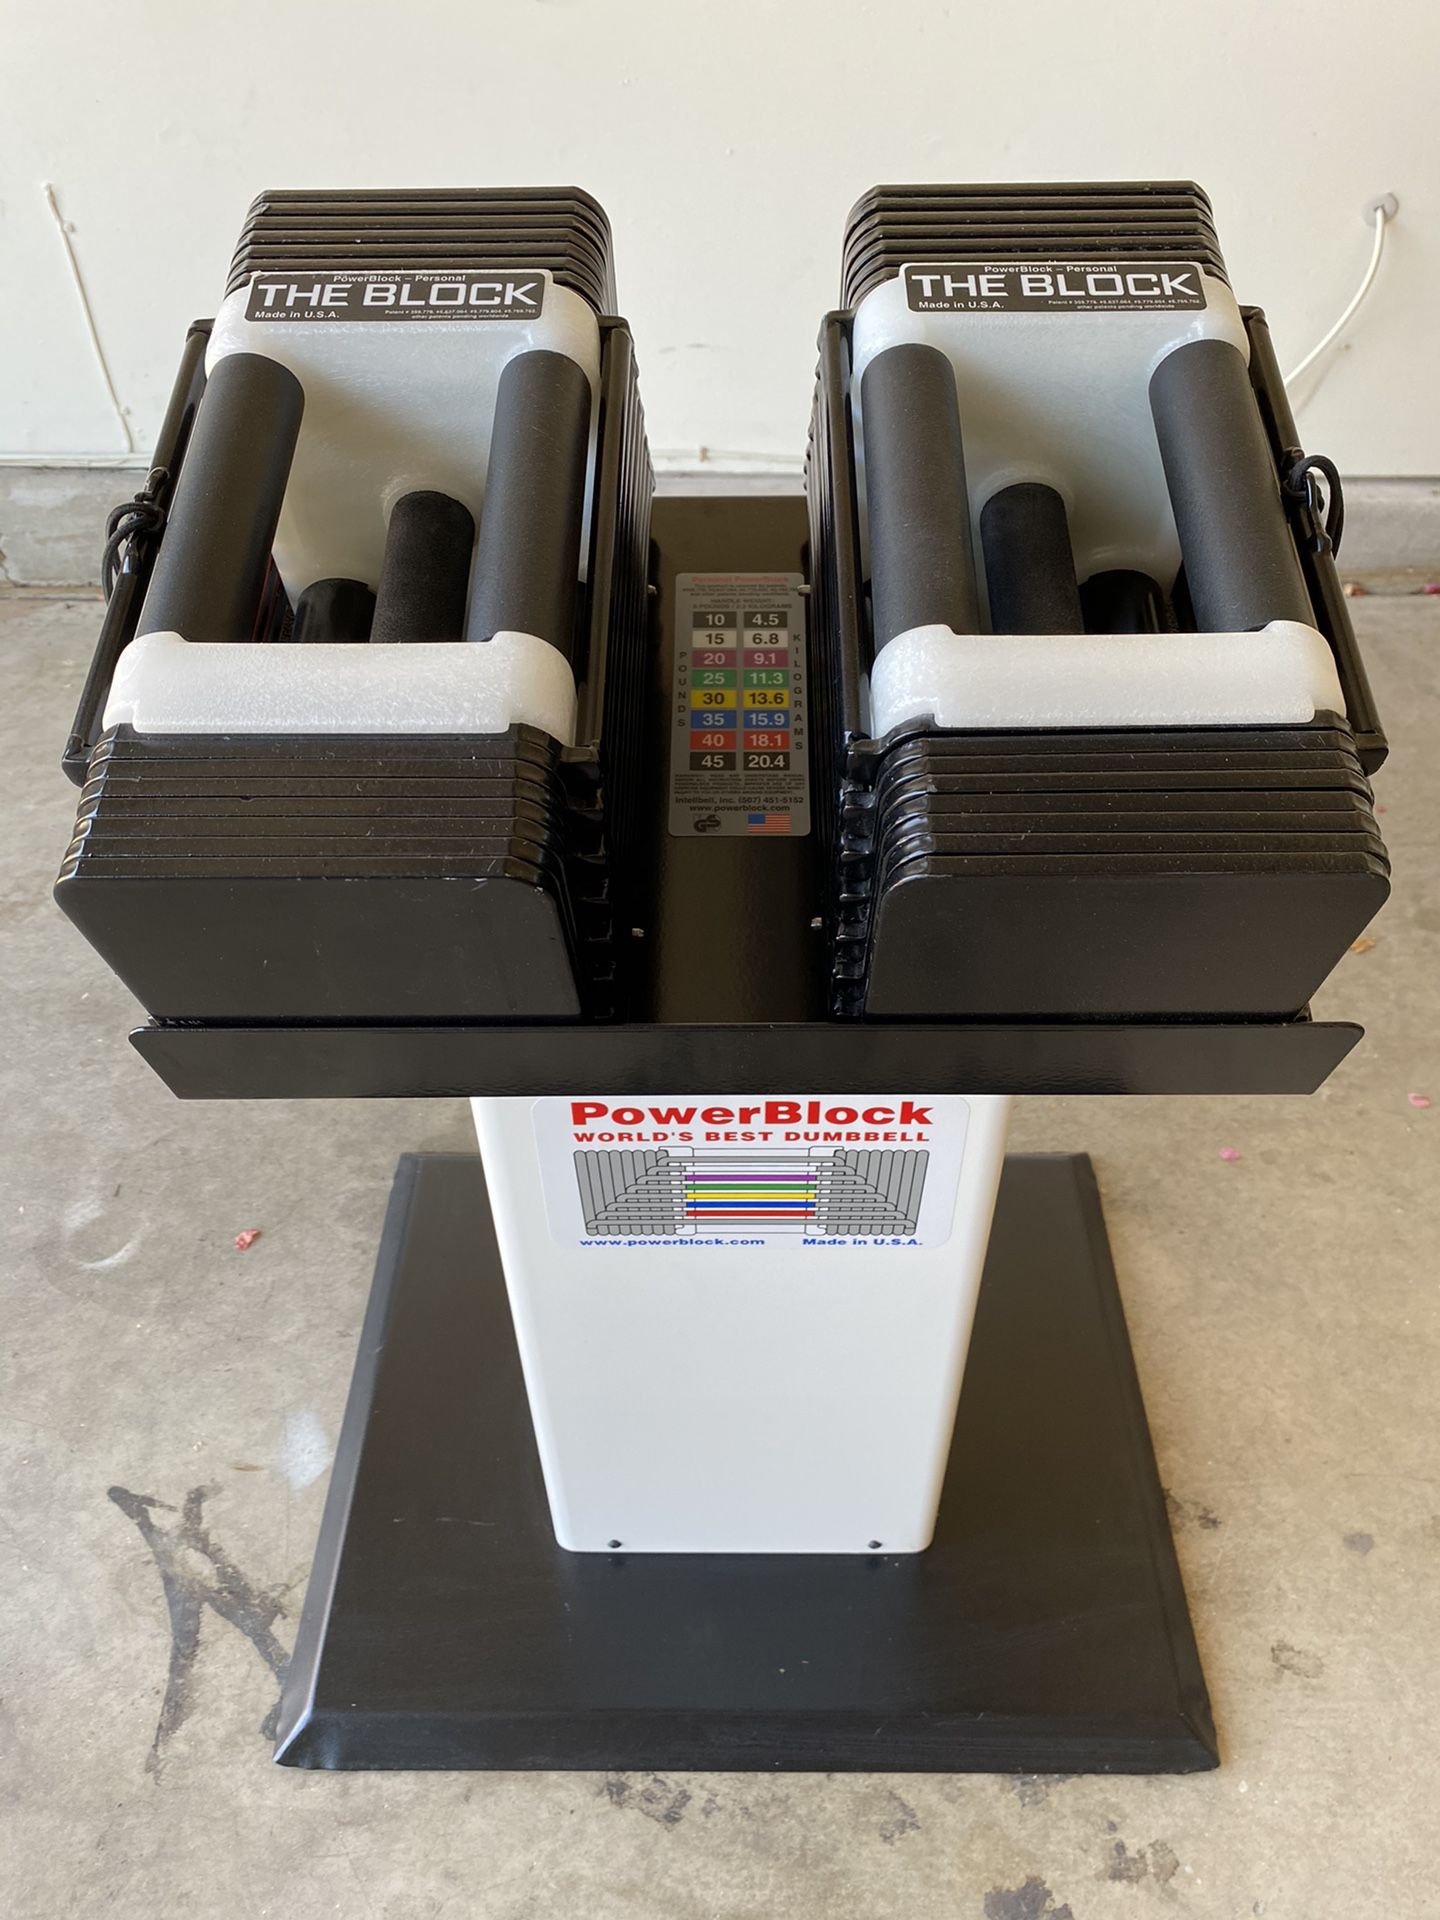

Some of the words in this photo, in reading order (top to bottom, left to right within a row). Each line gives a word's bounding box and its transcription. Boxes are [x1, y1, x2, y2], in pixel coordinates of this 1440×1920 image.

[984, 265, 1053, 273] PowerBlock
[1066, 265, 1117, 273] Personal
[911, 274, 1009, 297] THE
[1020, 273, 1199, 296] BLOCK
[257, 283, 353, 307] THE
[362, 282, 538, 306] BLOCK
[705, 614, 725, 625] 10
[752, 614, 779, 625] 4.5
[705, 633, 724, 644] 15
[752, 633, 779, 644] 6.8
[703, 653, 725, 665] 20
[754, 653, 776, 664] 9.1
[703, 673, 725, 685] 25
[750, 673, 783, 685] 11.3
[703, 693, 724, 705] 30
[749, 692, 784, 704] 13.6
[703, 713, 724, 725] 35
[750, 713, 785, 725] 15.9
[702, 734, 724, 746] 40
[750, 734, 782, 746] 18.1
[701, 755, 724, 768] 45
[748, 755, 785, 768] 20.4
[689, 804, 791, 812] www.powerblock.com
[570, 1101, 933, 1126] PowerBlock
[573, 1131, 694, 1142] WORLD'S
[705, 1131, 773, 1142] BEST
[784, 1131, 930, 1142] DUMBBELL
[579, 1237, 765, 1247] www.powerblock.com
[802, 1237, 847, 1246] Made
[852, 1237, 868, 1246] in
[873, 1237, 923, 1246] U.S.A.
